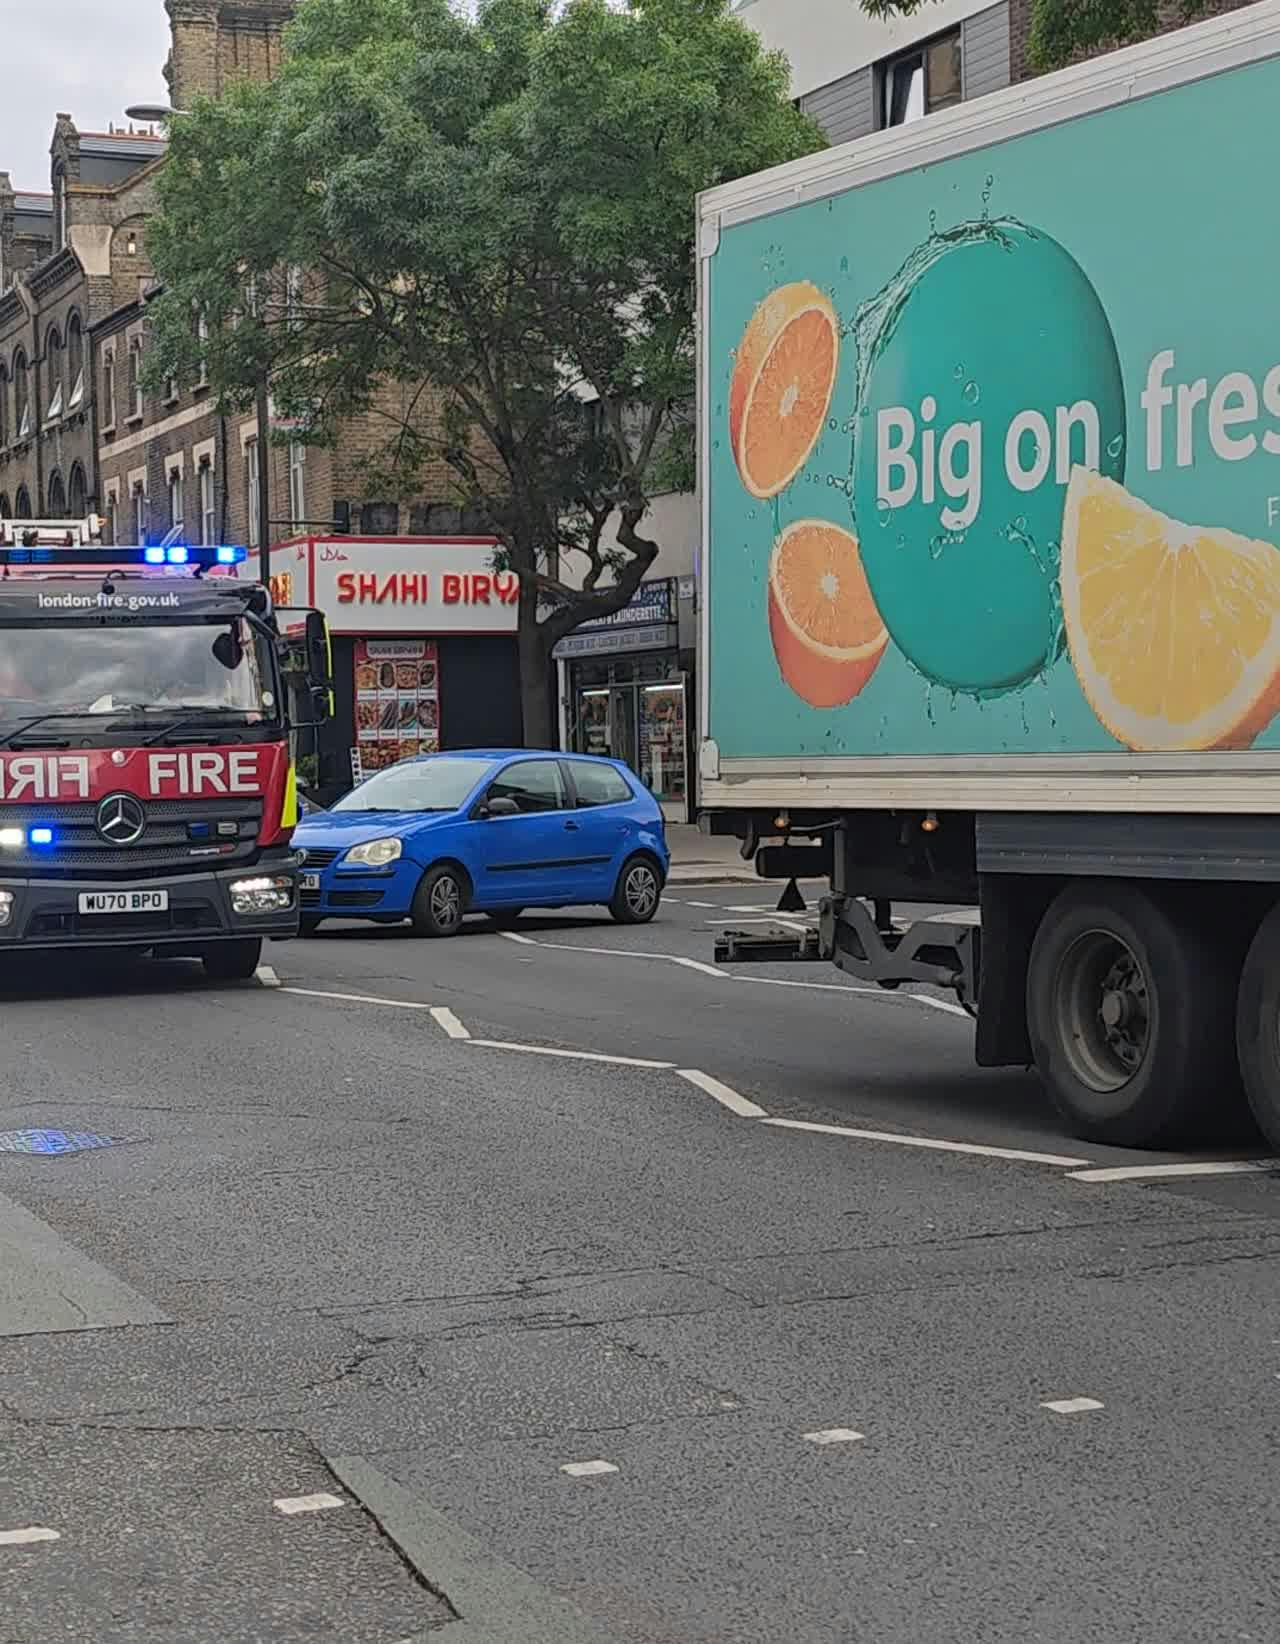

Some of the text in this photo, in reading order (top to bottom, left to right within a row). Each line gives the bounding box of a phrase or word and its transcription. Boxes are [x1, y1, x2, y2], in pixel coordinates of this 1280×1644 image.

[875, 396, 982, 528] Big
[1004, 398, 1102, 492] on
[38, 593, 180, 612] london-fire.gov.uk
[337, 573, 428, 604] SHAHI
[148, 751, 260, 795] FIRE
[86, 894, 127, 910] WU70
